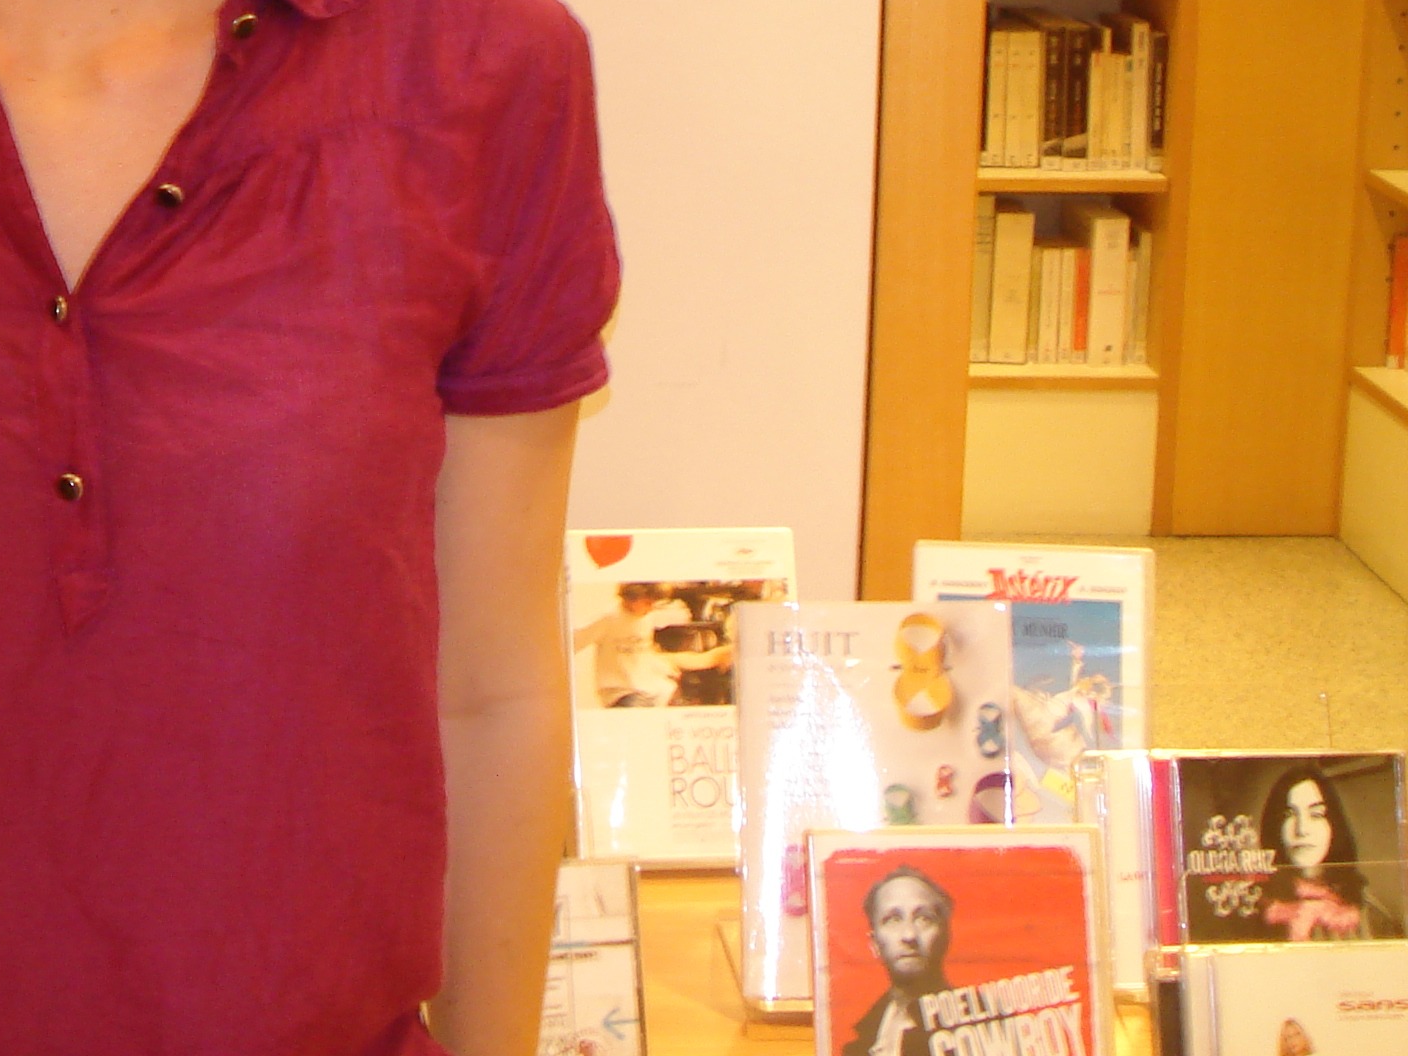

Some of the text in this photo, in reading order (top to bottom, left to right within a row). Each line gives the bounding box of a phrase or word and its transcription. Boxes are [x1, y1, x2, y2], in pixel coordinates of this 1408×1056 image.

[767, 630, 860, 656] HUIT
[670, 744, 738, 774] BALL
[671, 776, 735, 808] ROU
